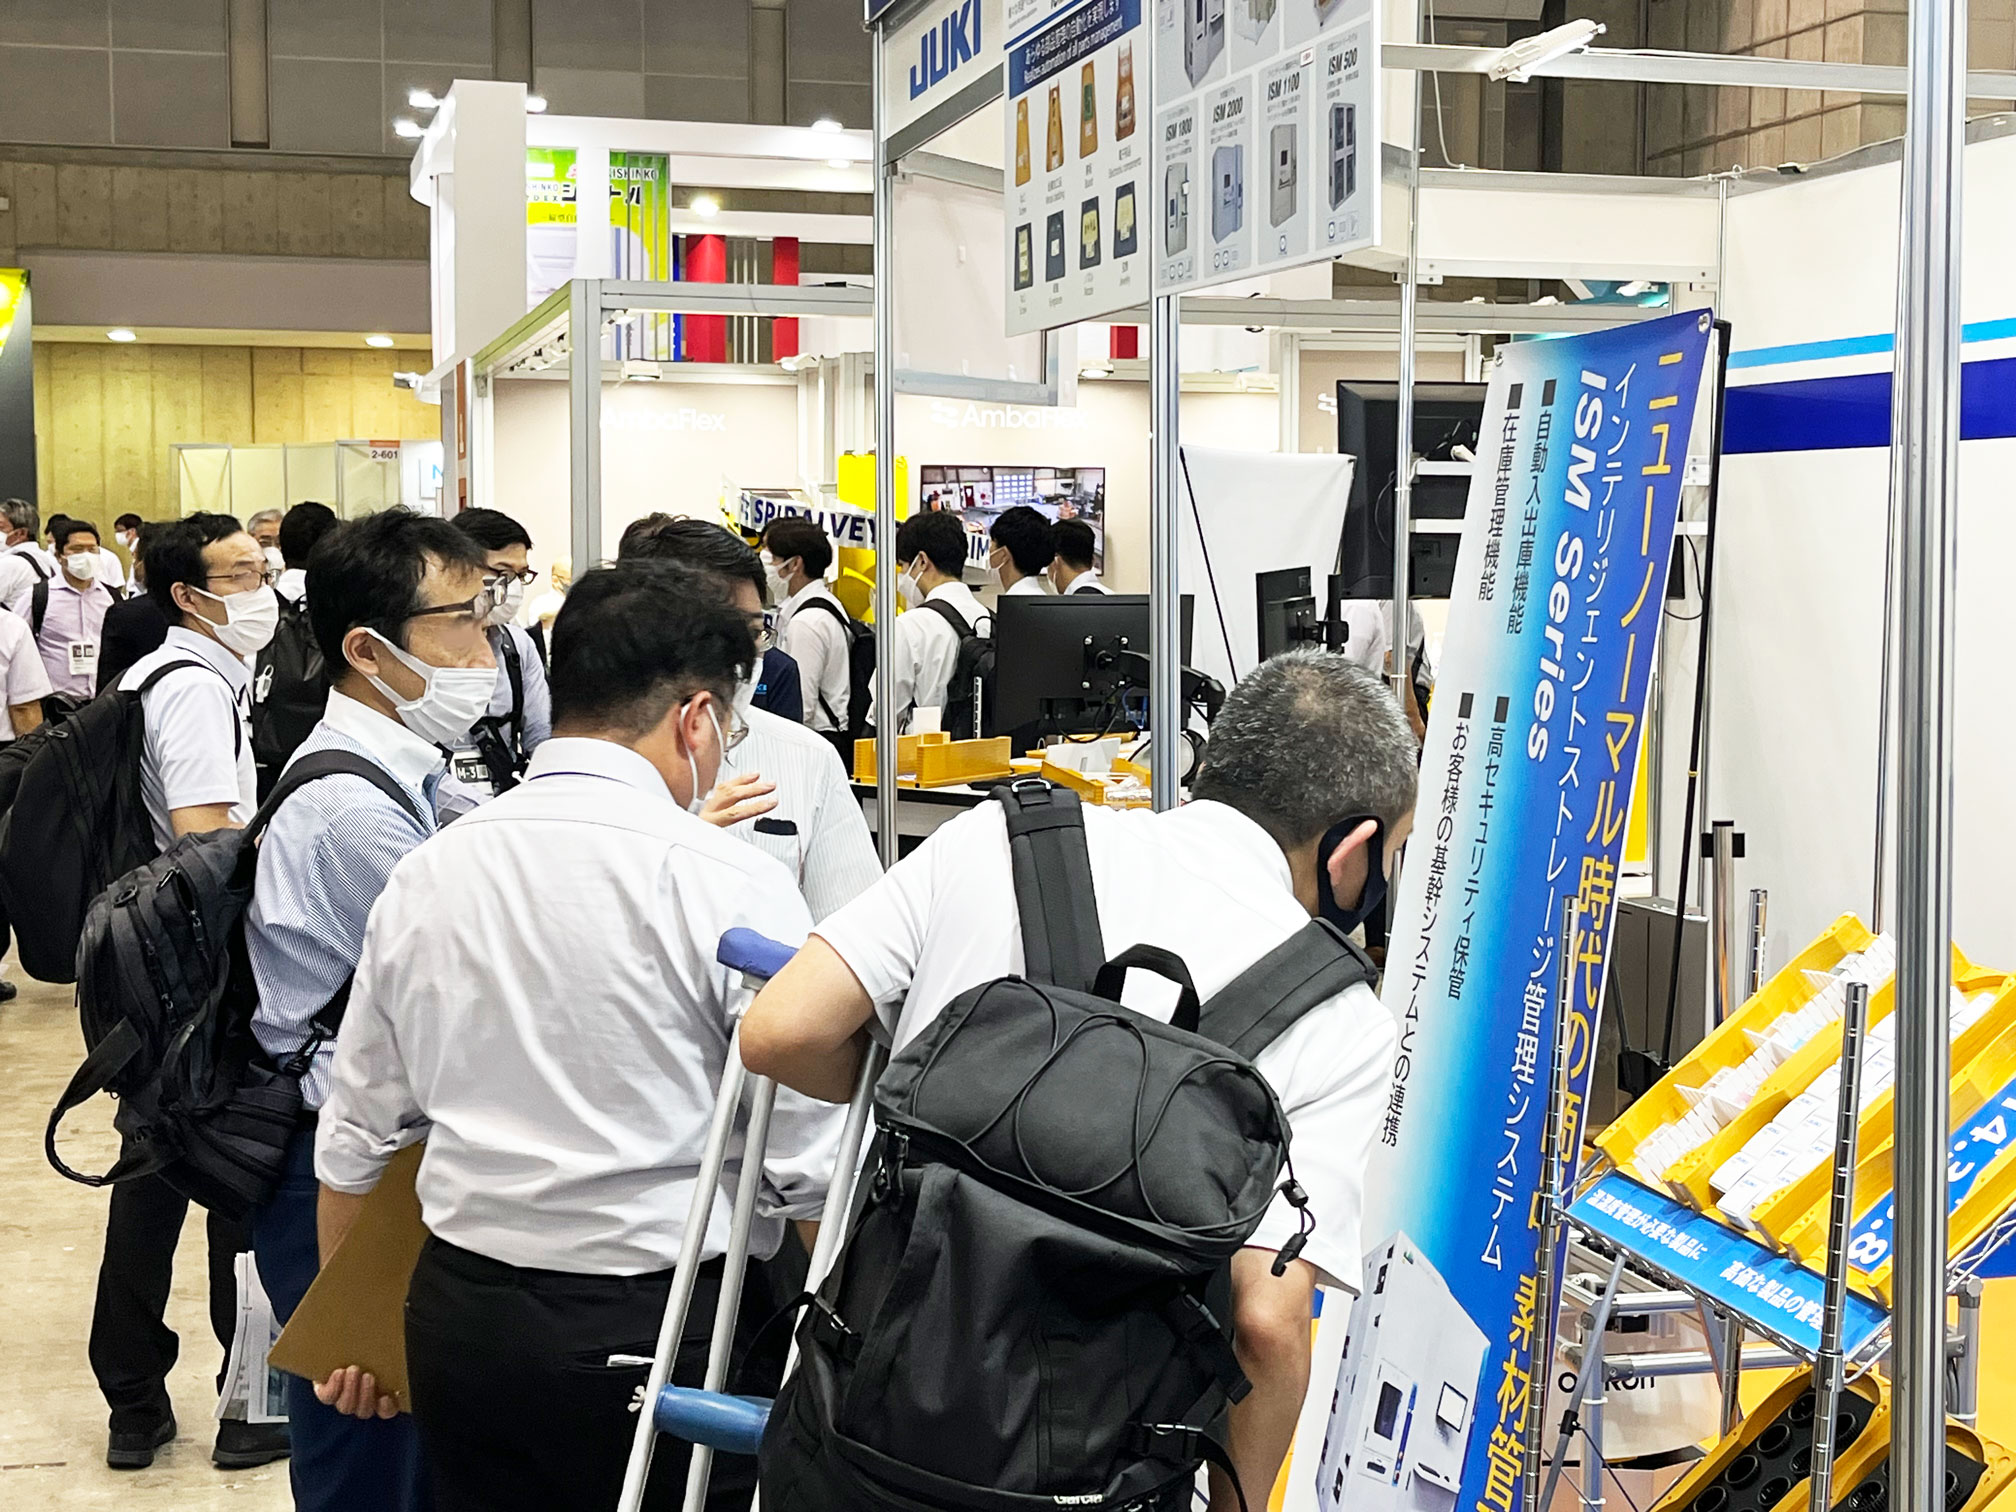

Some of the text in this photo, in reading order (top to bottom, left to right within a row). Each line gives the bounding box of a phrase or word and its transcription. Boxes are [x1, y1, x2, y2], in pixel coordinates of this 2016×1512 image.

[910, 0, 981, 101] JUKI
[1213, 102, 1227, 124] ISM
[1227, 96, 1243, 119] 2000
[1267, 78, 1282, 101] ISM
[1283, 72, 1300, 96] 1100
[1328, 47, 1358, 76] ISM 500
[1165, 122, 1178, 142] ISM
[371, 450, 398, 459] 2-601
[1478, 412, 1521, 602] 在庫管理機能
[1506, 410, 1555, 635] 自動入出庫機能
[1527, 370, 1608, 762] ISM Series
[1448, 727, 1506, 1000] 高セキュリティ保管
[1481, 362, 1637, 1271] インテリジェントストレージ管理システム
[1382, 722, 1470, 1148] お客様の基幹システムとの連携
